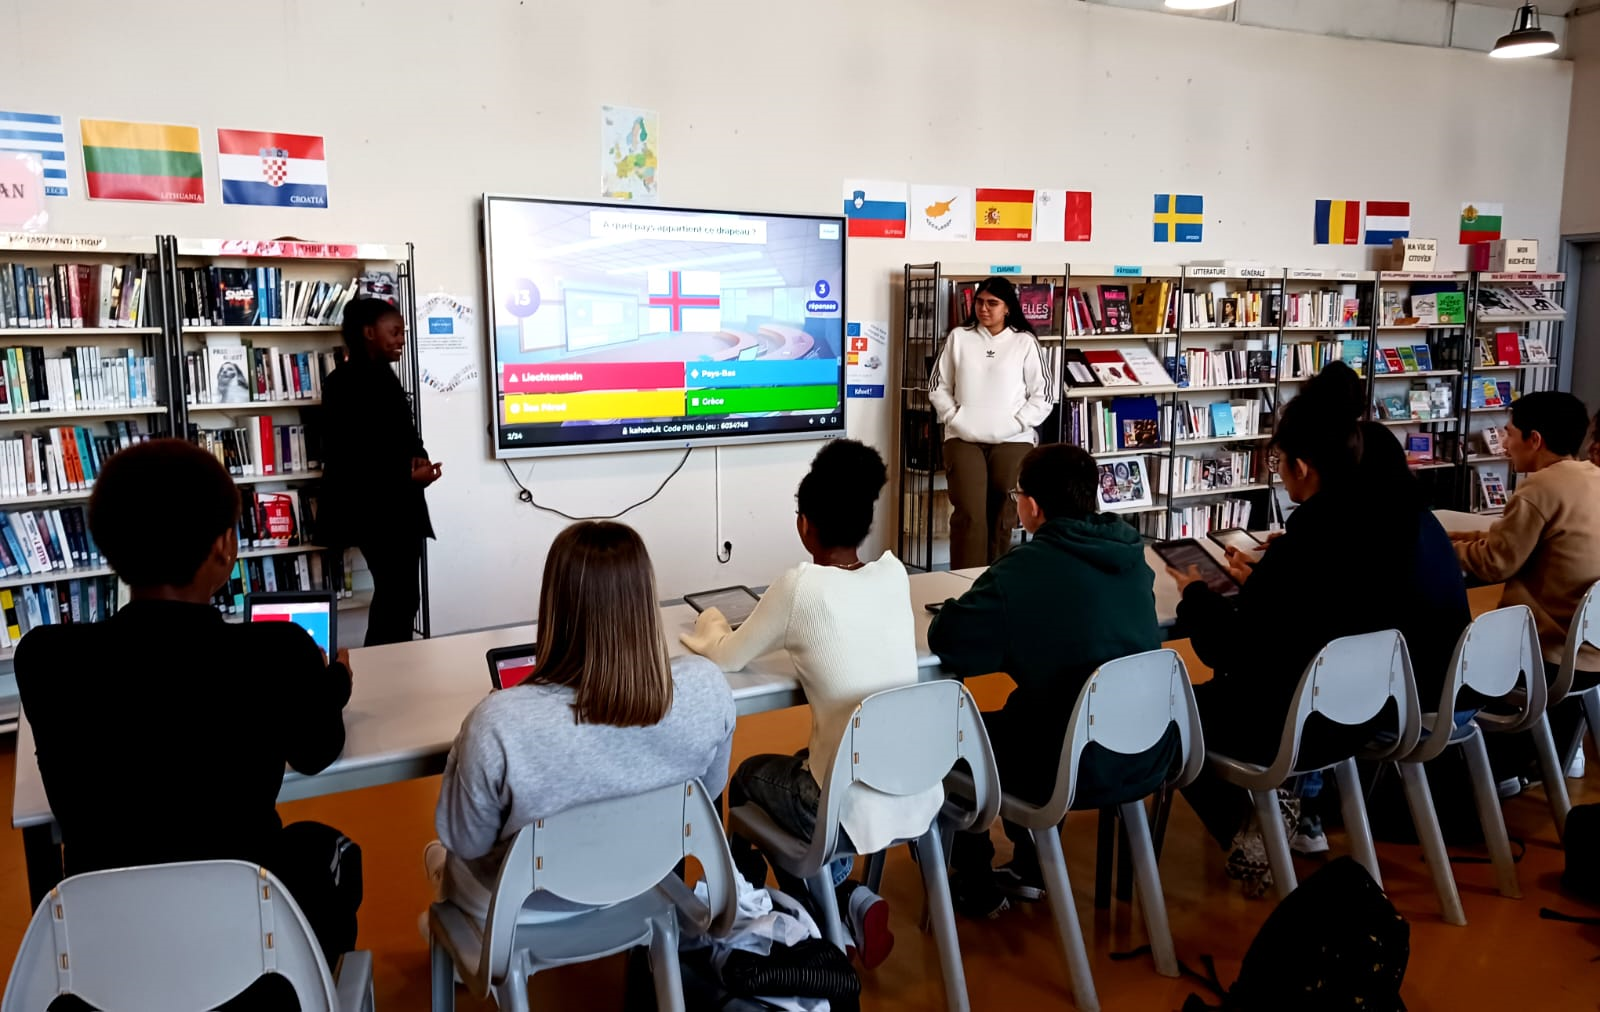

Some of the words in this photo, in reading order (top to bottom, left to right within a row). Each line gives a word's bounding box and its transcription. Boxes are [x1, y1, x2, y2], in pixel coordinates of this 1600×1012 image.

[160, 191, 202, 201] LITHUANIA
[290, 195, 324, 204] CROATIA
[634, 224, 655, 232] pays
[657, 225, 702, 233] appartient
[717, 226, 750, 236] drapeau
[819, 284, 826, 294] 3
[514, 289, 531, 306] 13
[808, 302, 837, 311] réponses
[1022, 303, 1049, 314] ELLES
[521, 372, 583, 382] Liechtenstein
[701, 369, 736, 378] Pays-Bas
[702, 397, 725, 405] Grèce
[663, 424, 681, 432] Code
[682, 423, 694, 431] PIN
[695, 422, 704, 430] du
[704, 421, 716, 431] jeu
